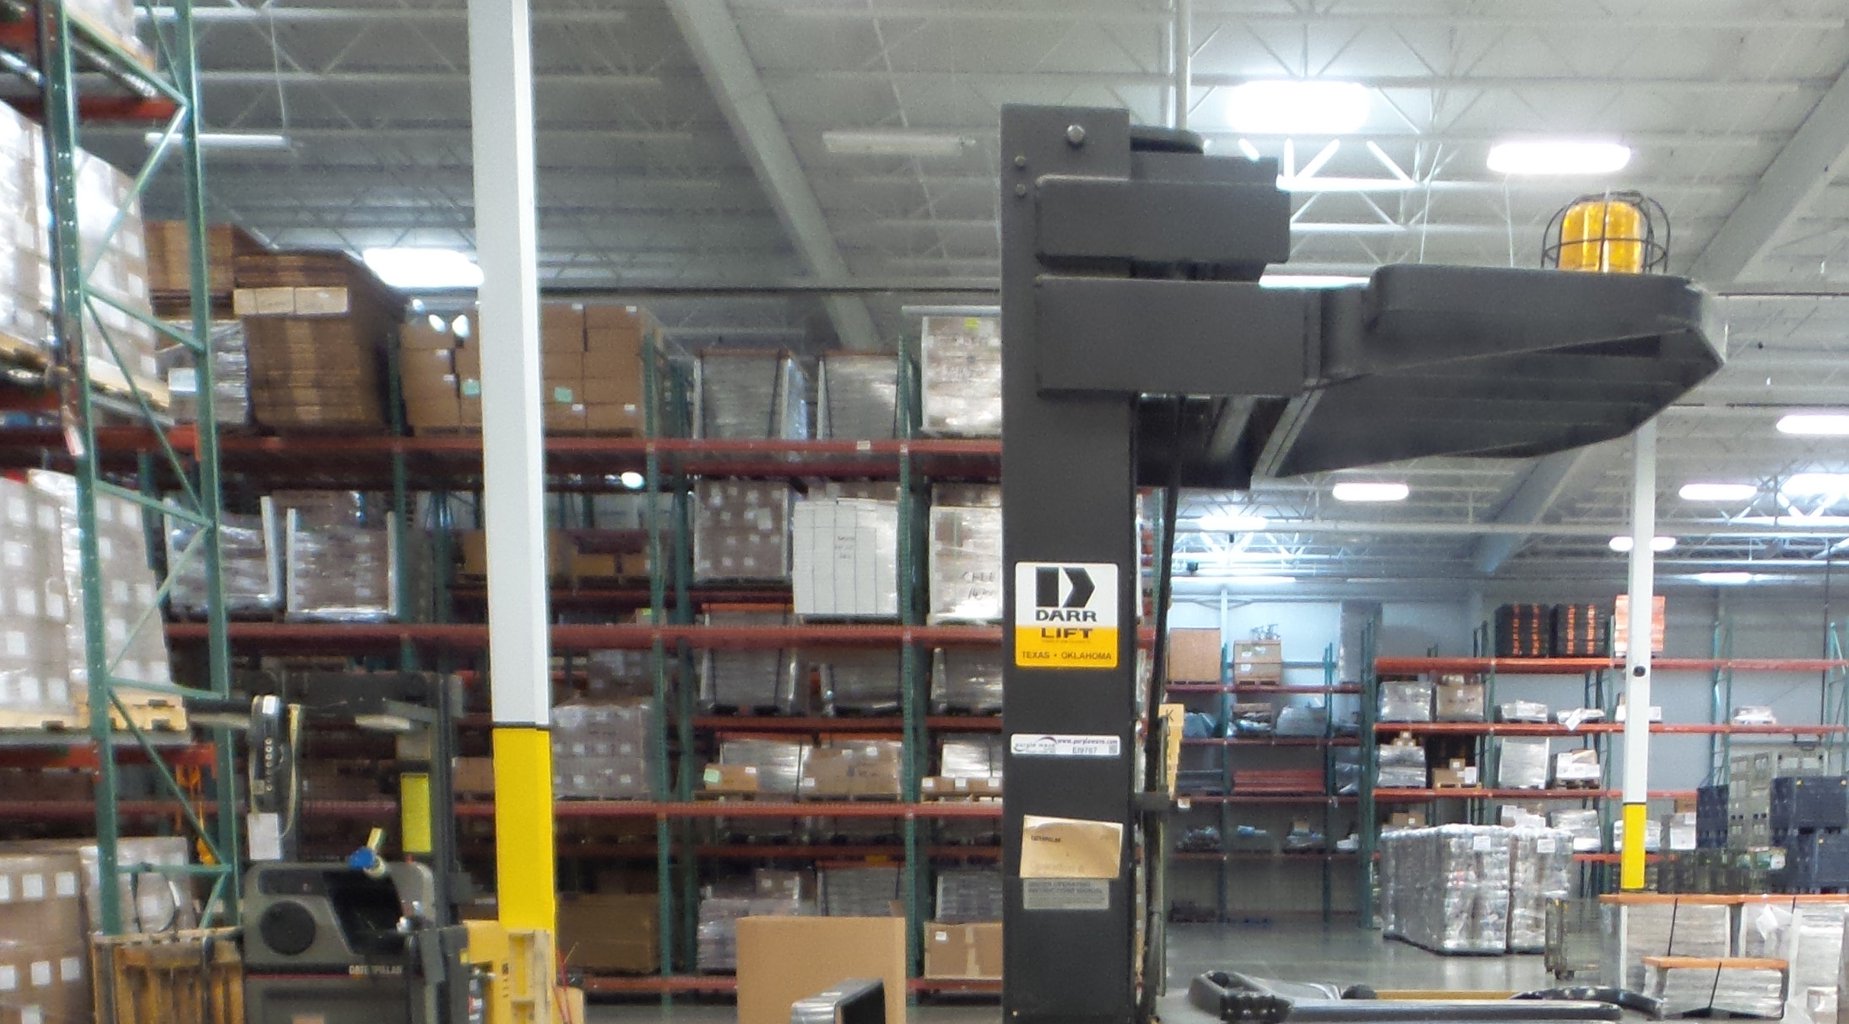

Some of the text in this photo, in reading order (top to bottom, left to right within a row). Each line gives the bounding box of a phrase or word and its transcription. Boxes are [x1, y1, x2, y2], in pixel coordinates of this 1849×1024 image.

[1035, 609, 1097, 622] DARR
[1041, 628, 1093, 639] LIFT
[1022, 651, 1112, 660] TEXAS OKLAHOMA
